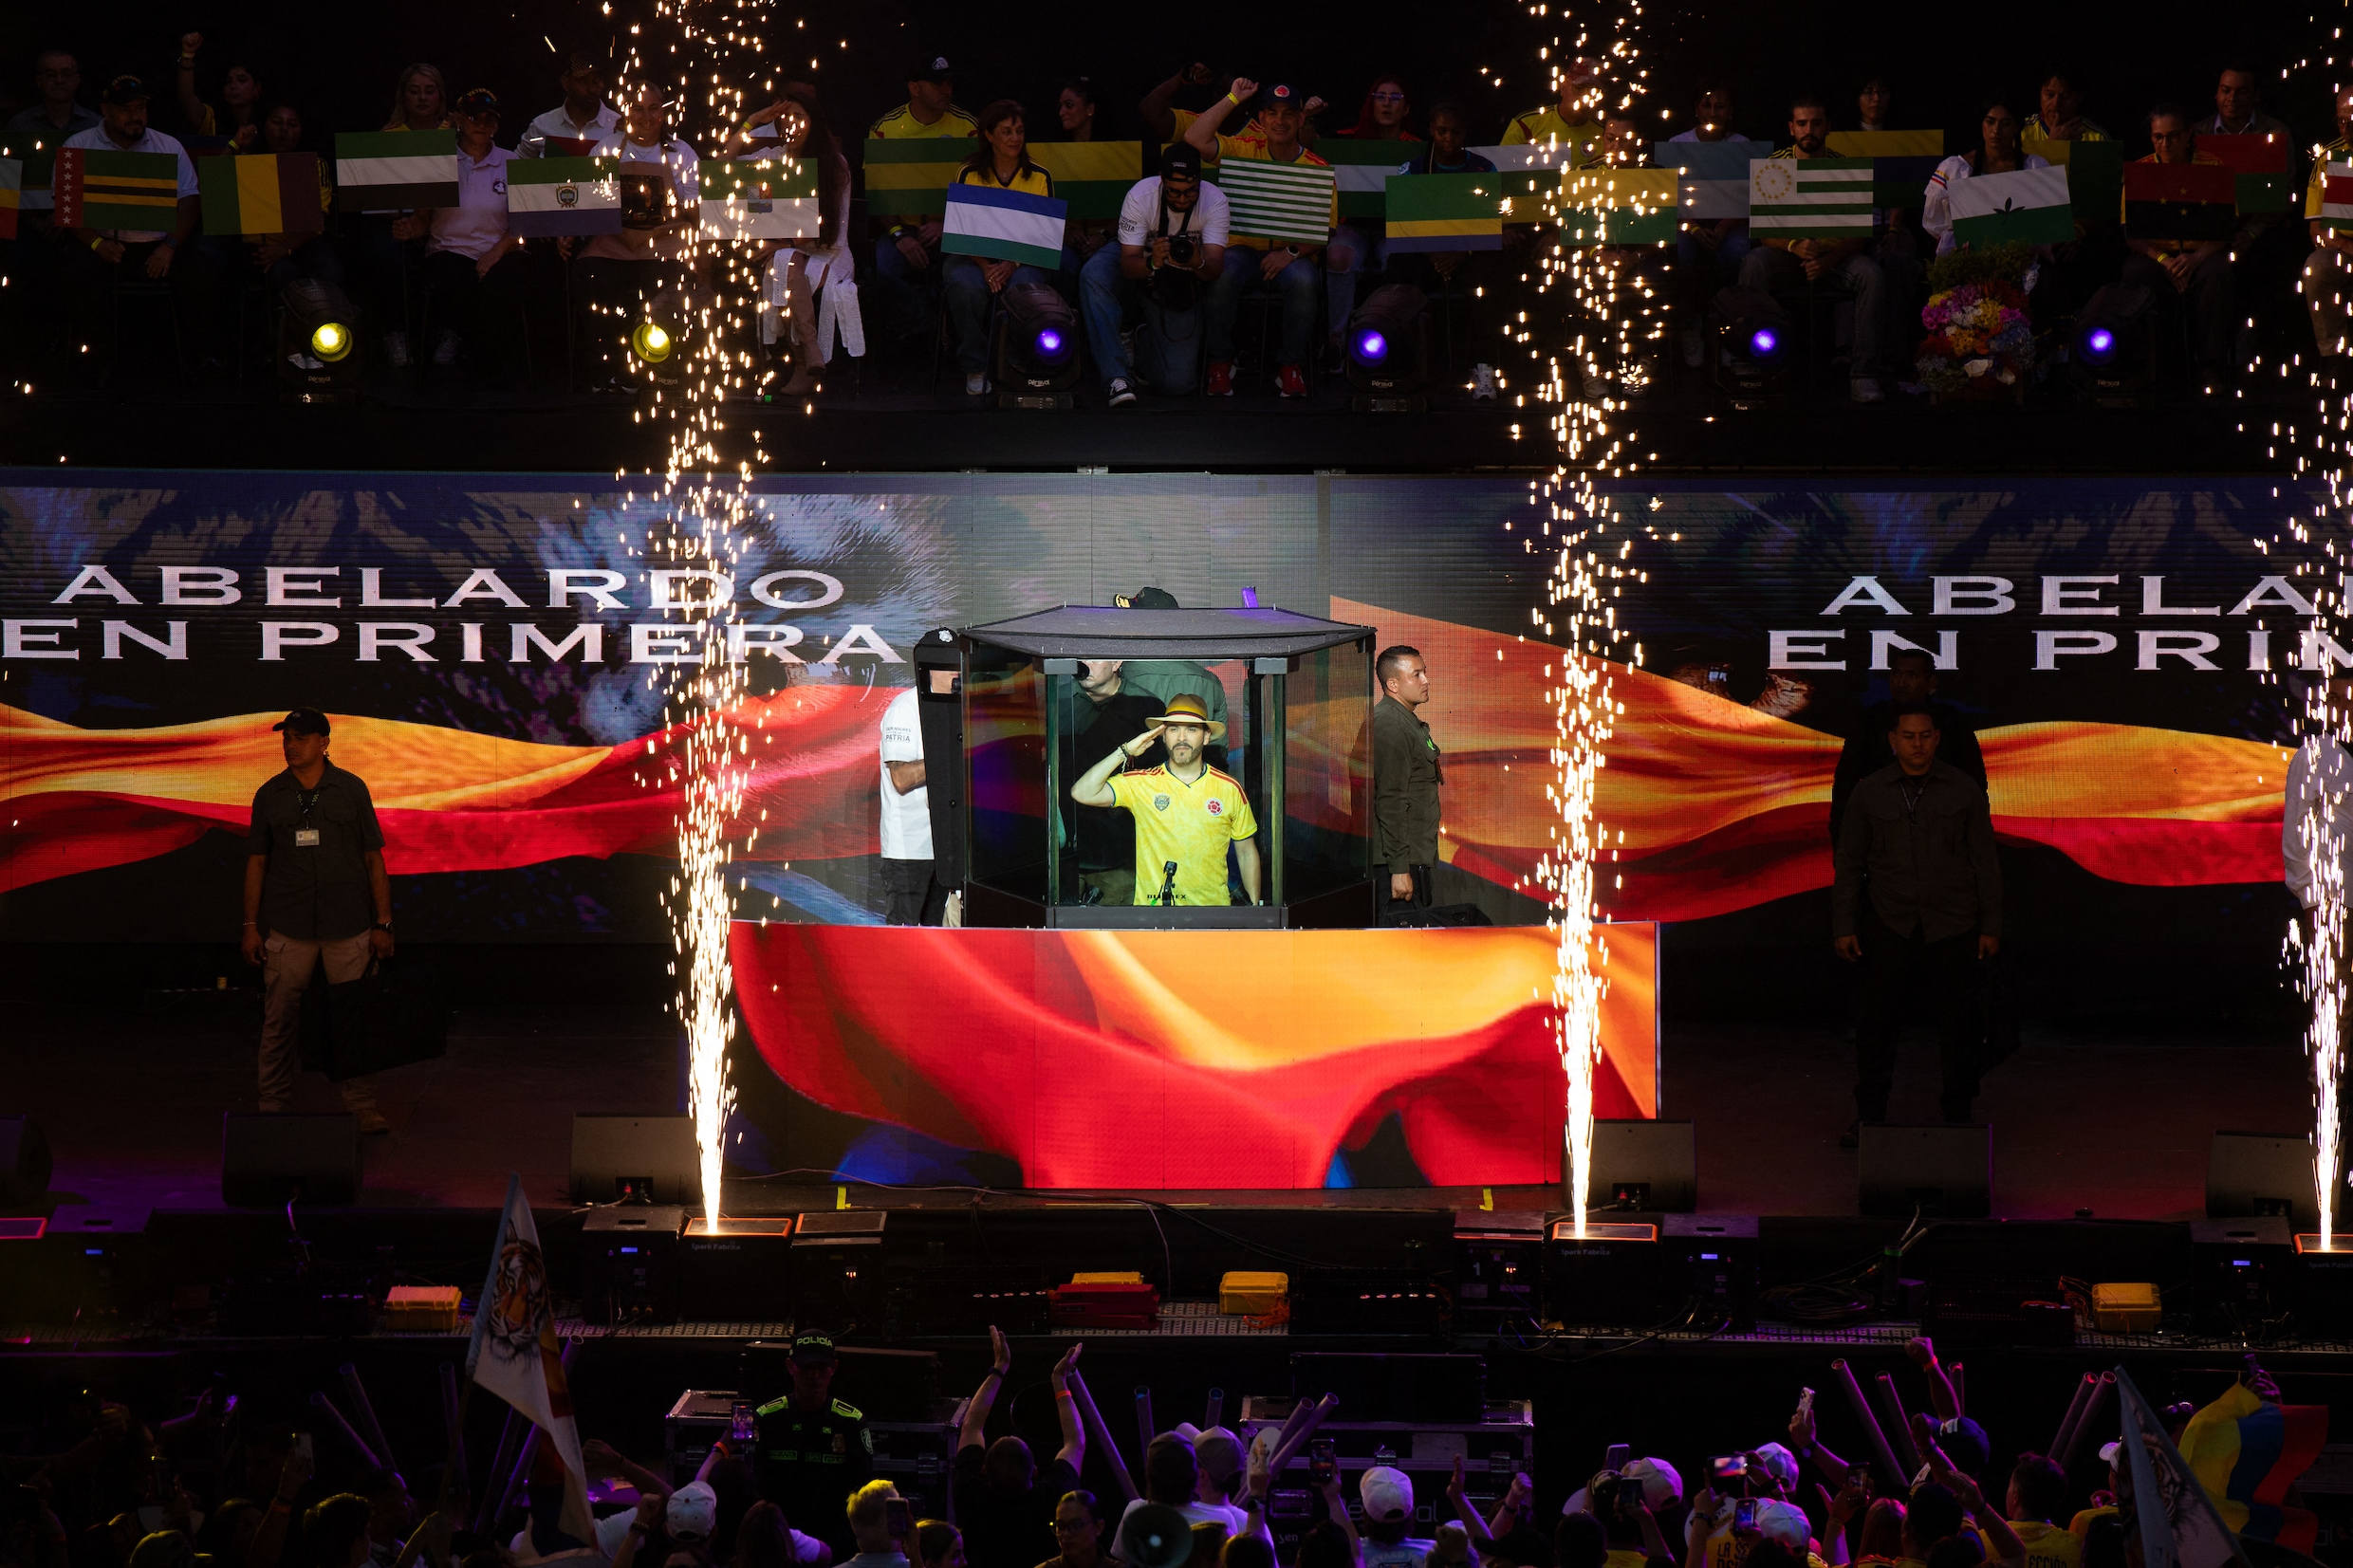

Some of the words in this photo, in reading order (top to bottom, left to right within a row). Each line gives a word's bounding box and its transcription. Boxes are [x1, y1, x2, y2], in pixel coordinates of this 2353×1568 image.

[50, 564, 843, 611] ABELARDO
[1820, 574, 2353, 618] ABELA
[1, 618, 189, 660] EN
[257, 620, 906, 664] PRIMERA
[1768, 629, 1960, 672] EN
[691, 1243, 713, 1251] Spark
[1560, 1248, 1582, 1257] Spark
[1583, 1246, 1611, 1256] Fabrica
[1473, 1262, 1480, 1276] 1
[2308, 1262, 2330, 1270] Spark
[796, 1336, 834, 1348] POLICÍA
[1717, 1541, 1731, 1559] LA
